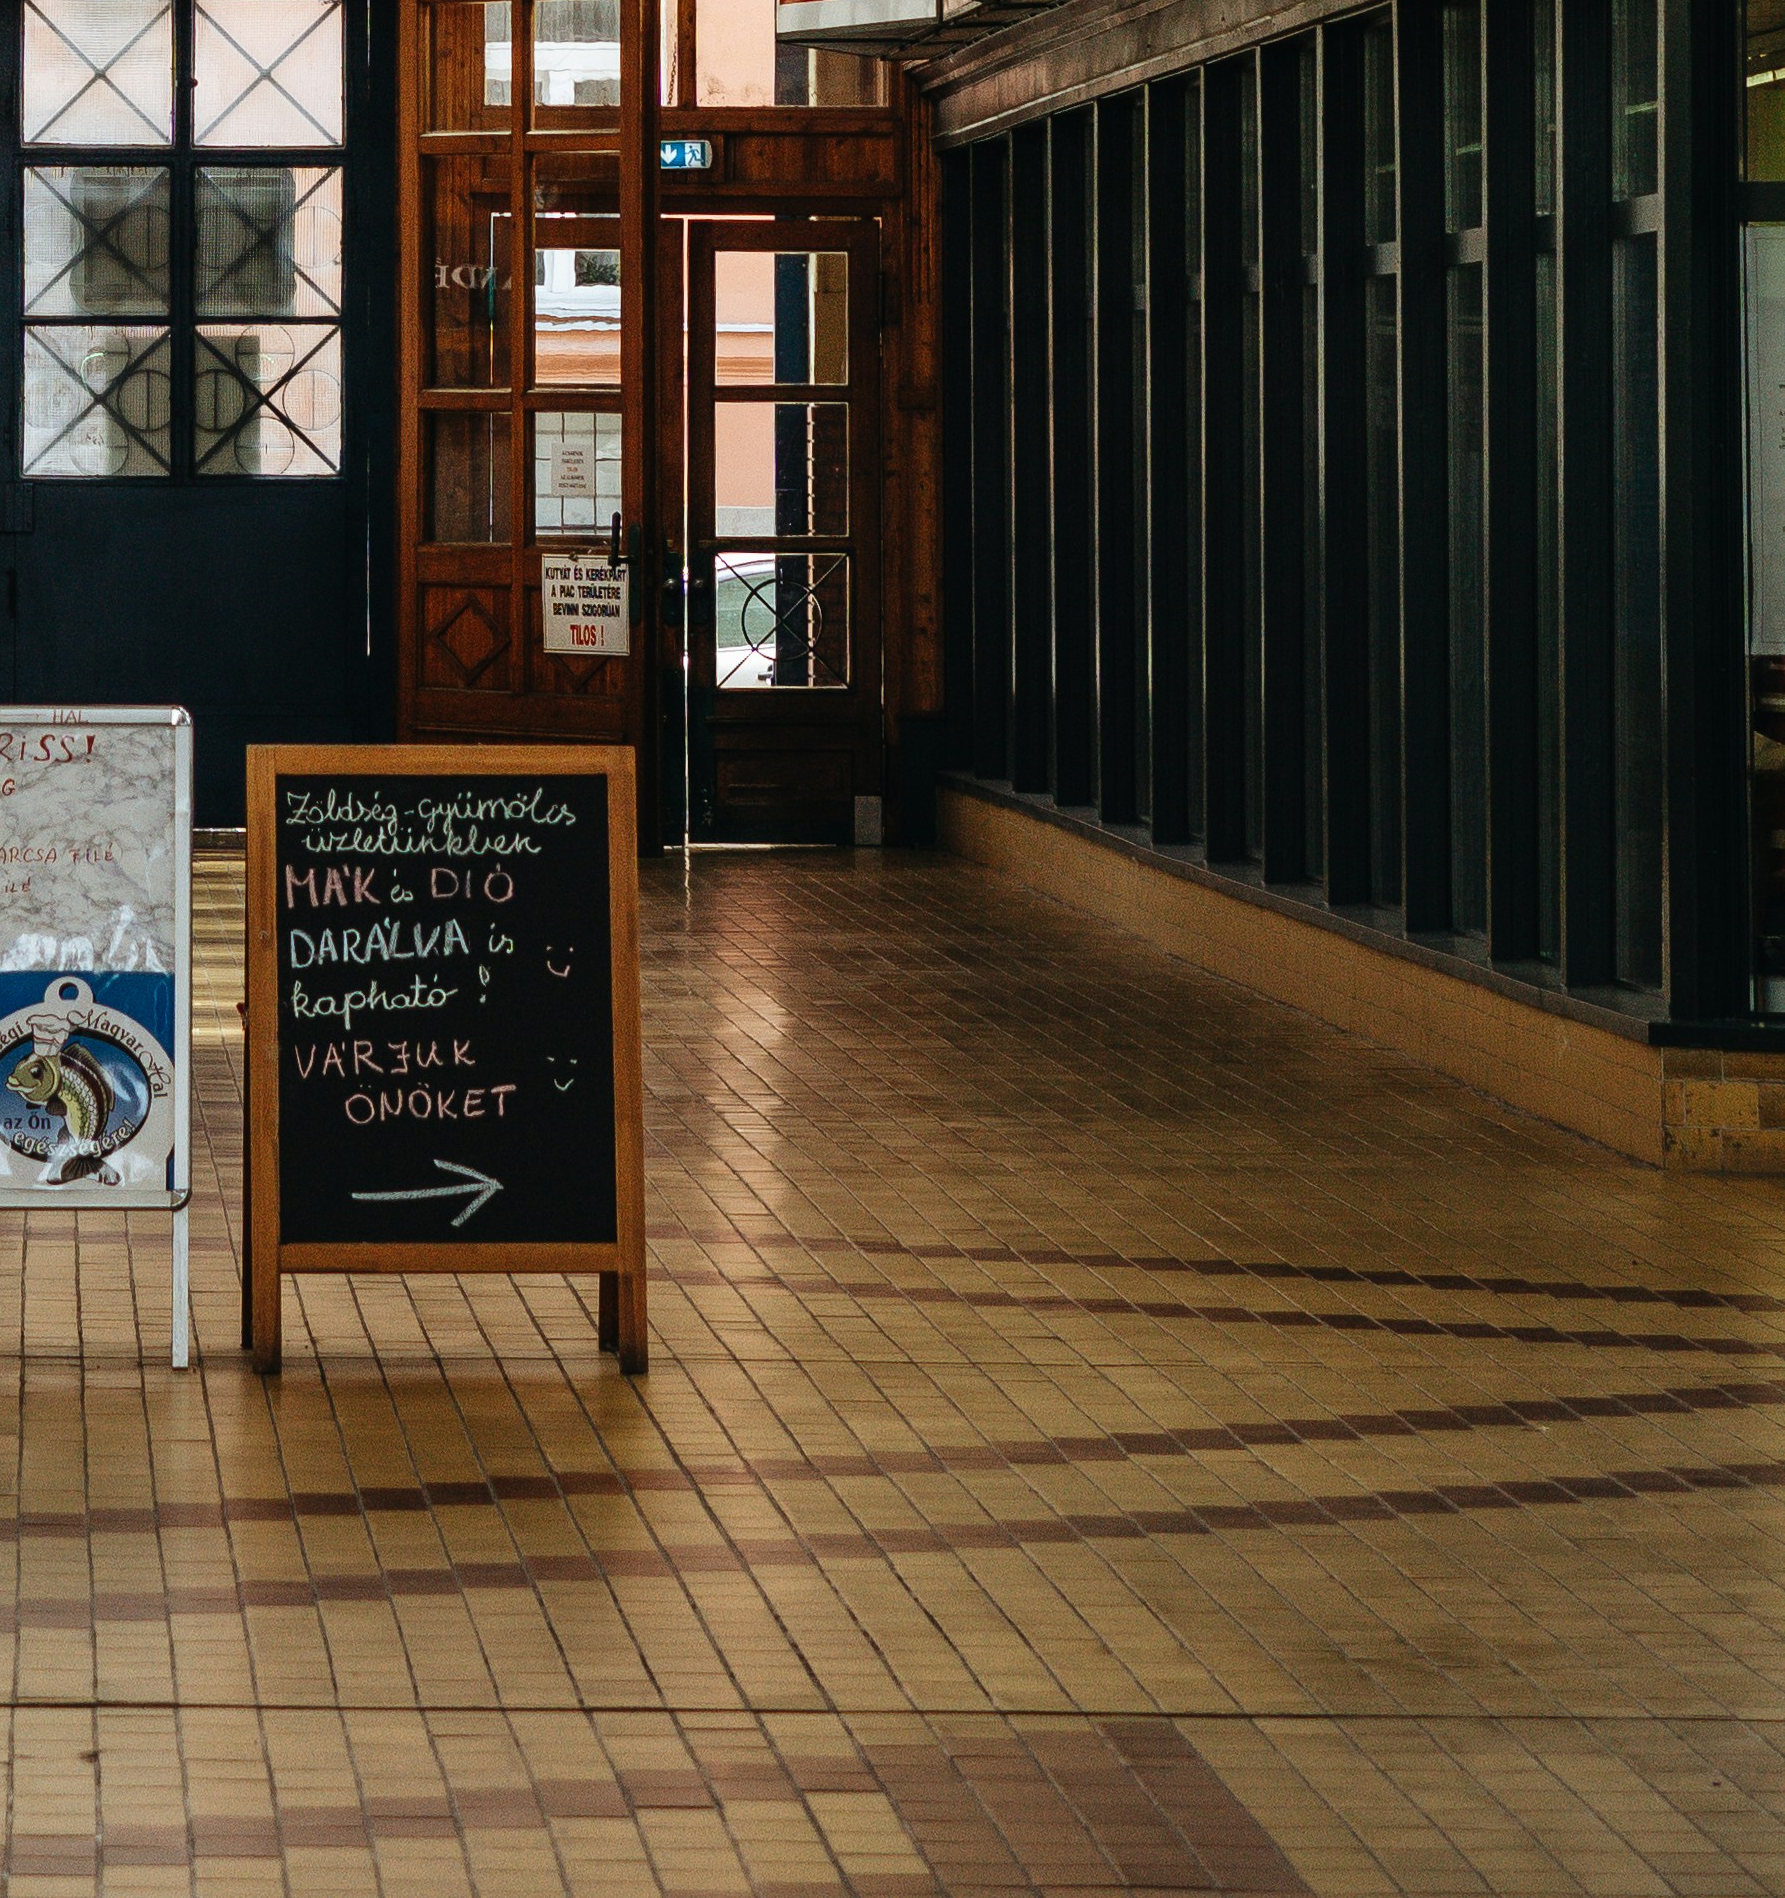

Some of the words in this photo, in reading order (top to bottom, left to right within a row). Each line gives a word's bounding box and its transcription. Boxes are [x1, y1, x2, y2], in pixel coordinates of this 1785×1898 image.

[545, 565, 571, 580] KUTYÁT
[574, 565, 583, 581] ÉS
[551, 584, 556, 597] A
[560, 585, 575, 598] PIAC
[570, 624, 596, 646] TILOS
[53, 709, 90, 725] HAL
[285, 863, 381, 908] MÁK
[389, 868, 414, 902] és
[430, 862, 514, 902] DIÓ
[290, 916, 470, 969] DARÁLVA
[488, 922, 514, 954] is
[291, 974, 459, 1030] kapható
[66, 1009, 144, 1052] Magyar
[138, 1050, 172, 1098] Hal
[294, 1038, 476, 1078] VÁRJUK
[3, 1116, 22, 1129] az
[345, 1083, 517, 1124] ÖNÖKET
